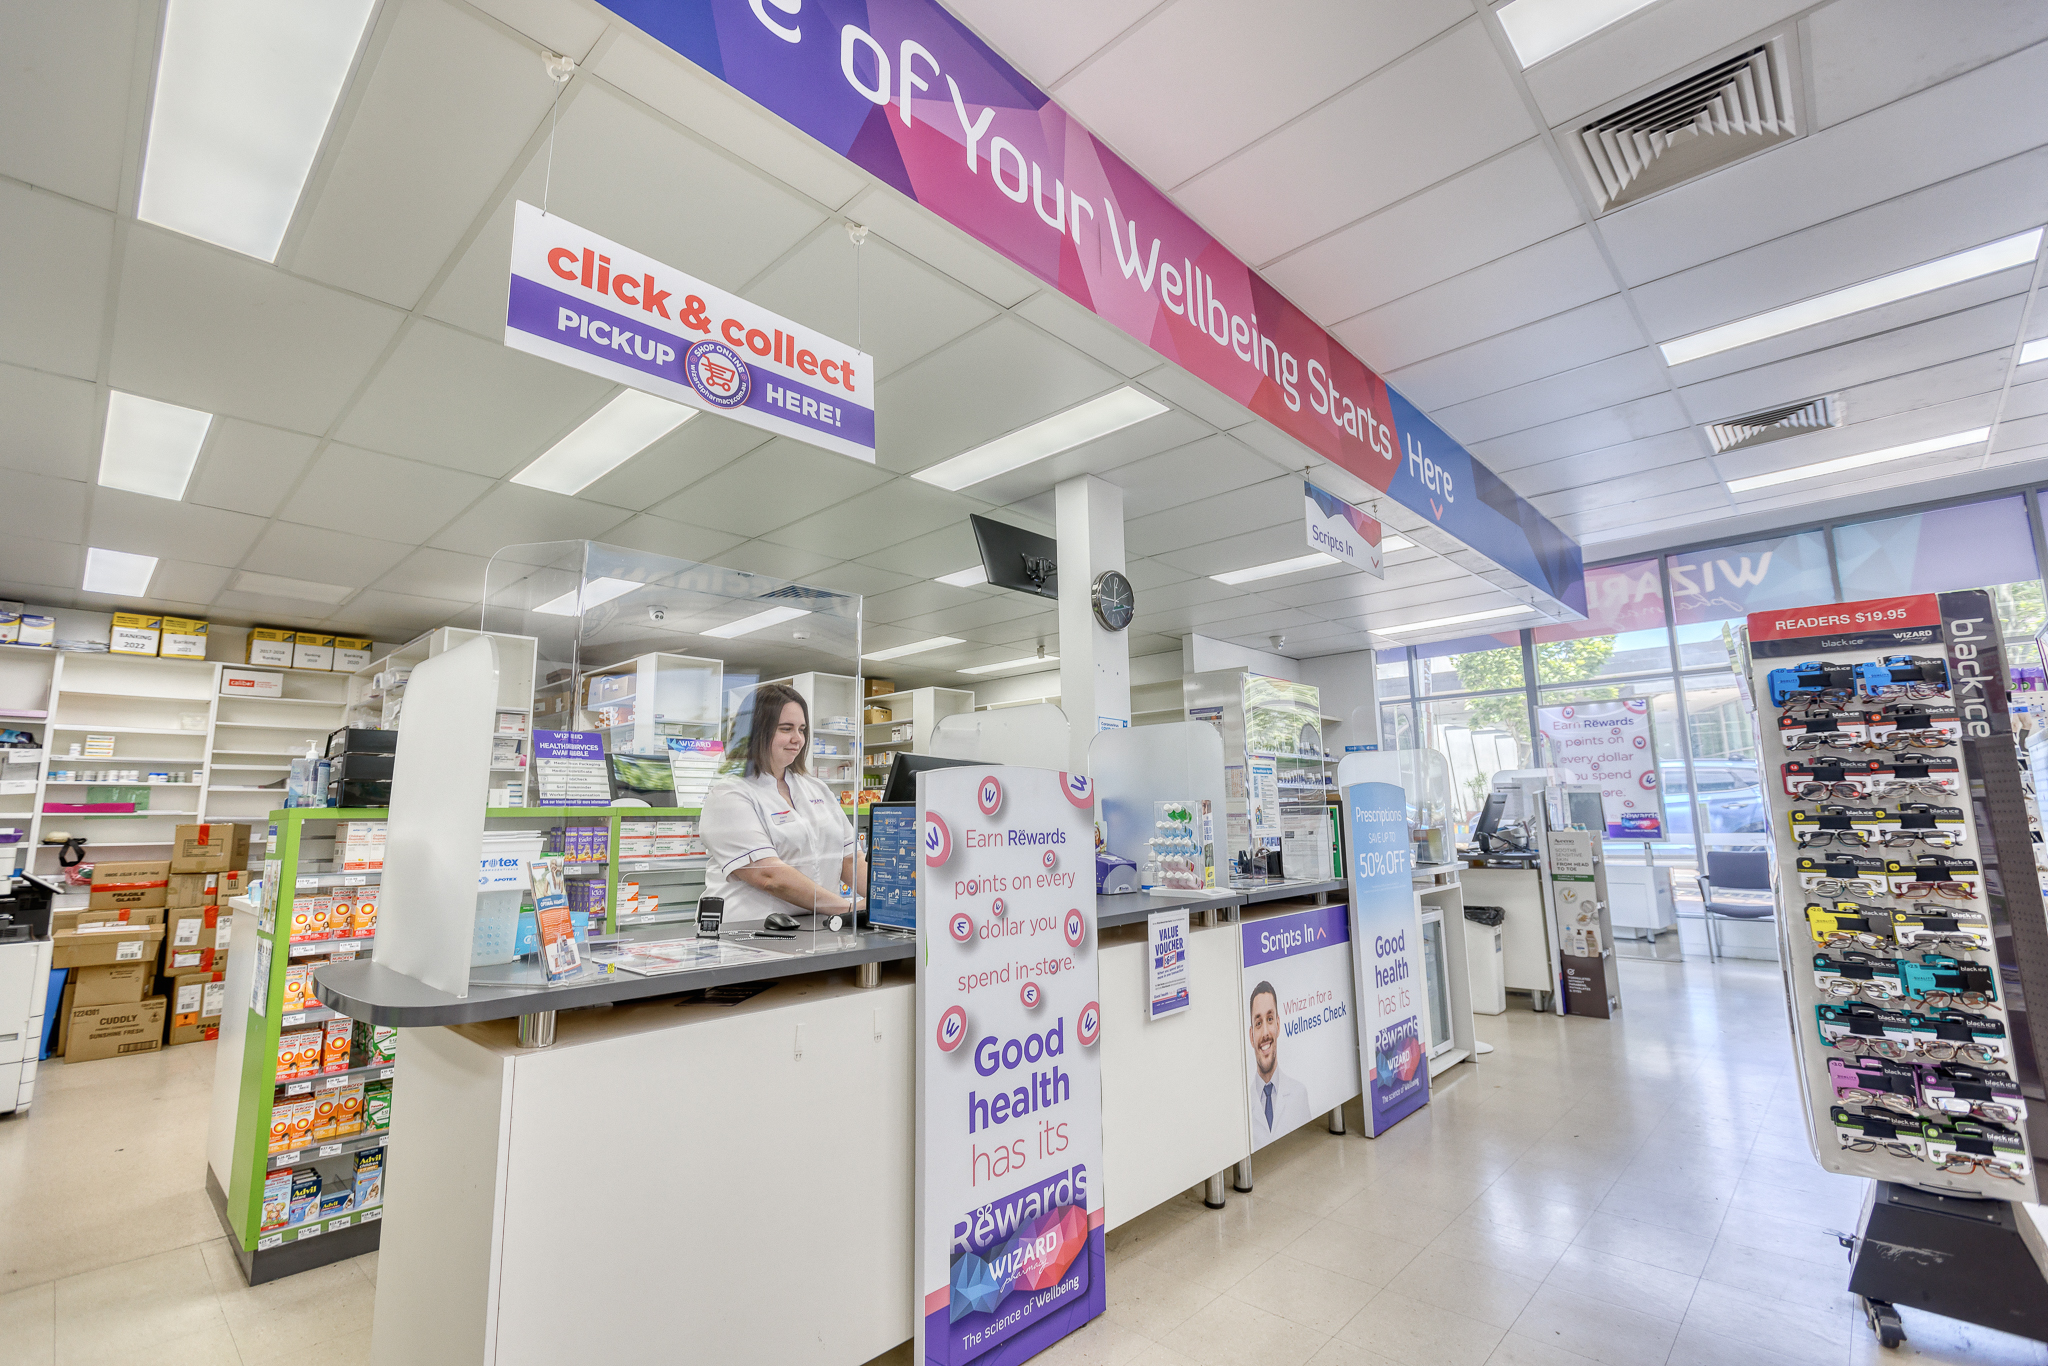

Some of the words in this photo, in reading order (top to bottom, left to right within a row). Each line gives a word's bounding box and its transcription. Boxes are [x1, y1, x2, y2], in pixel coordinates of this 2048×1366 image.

[841, 24, 940, 128] of
[945, 73, 1094, 245] Your
[1105, 197, 1300, 411] Wellbeing
[1308, 359, 1392, 459] Starts
[1407, 433, 1454, 503] Here
[547, 247, 671, 320] click
[679, 294, 712, 334] &
[721, 318, 855, 392] collect
[557, 307, 675, 366] PICKUP
[766, 382, 841, 427] HERE!
[694, 344, 714, 357] SHOP
[717, 346, 744, 373] ONLINE
[1312, 525, 1343, 552] Scripts
[1346, 541, 1353, 557] In
[1776, 614, 1850, 630] READERS
[1855, 609, 1906, 623] $19.95
[1893, 630, 1932, 640] WIZARD
[1554, 721, 1580, 730] Earn
[1608, 736, 1624, 744] on
[1561, 756, 1593, 764] every
[1598, 753, 1634, 762] dollar
[1593, 770, 1631, 781] spend
[1356, 807, 1402, 826] Prescriptions
[966, 830, 1003, 848] Earn
[1369, 832, 1381, 843] SAVE
[1389, 832, 1395, 842] TO
[1360, 852, 1385, 878] 50%
[1386, 850, 1405, 874] OFF
[1013, 875, 1031, 890] on
[1036, 871, 1075, 888] every
[979, 917, 1025, 939] dollar
[1030, 915, 1057, 936] you
[1159, 925, 1178, 941] VALUE
[1261, 929, 1301, 954] Scripts
[1304, 924, 1314, 943] In
[1155, 938, 1183, 956] VOUCHER
[1375, 929, 1405, 958] Good
[958, 962, 1009, 994] spend
[1375, 957, 1409, 988] health
[1283, 998, 1307, 1015] Whizz
[1308, 994, 1315, 1005] in
[1316, 991, 1326, 1003] for
[1328, 990, 1332, 1000] a
[1378, 994, 1396, 1017] has
[1399, 987, 1410, 1008] its
[100, 1014, 138, 1025] CUDDLY
[1284, 1014, 1321, 1037] Wellness
[1324, 1001, 1346, 1023] Check
[89, 1031, 121, 1039] SUNSHINE
[974, 1017, 1064, 1077] Good
[1387, 1050, 1409, 1070] WIZARD
[969, 1065, 1069, 1134] health
[360, 1154, 381, 1164] Advil
[972, 1139, 1025, 1187] has
[1039, 1120, 1069, 1160] its
[293, 1186, 316, 1197] Advil
[988, 1232, 1057, 1282] WIZARD
[962, 1332, 981, 1351] The
[984, 1311, 1021, 1337] science
[1024, 1299, 1034, 1316] of
[1035, 1275, 1079, 1309] Wellbeing
